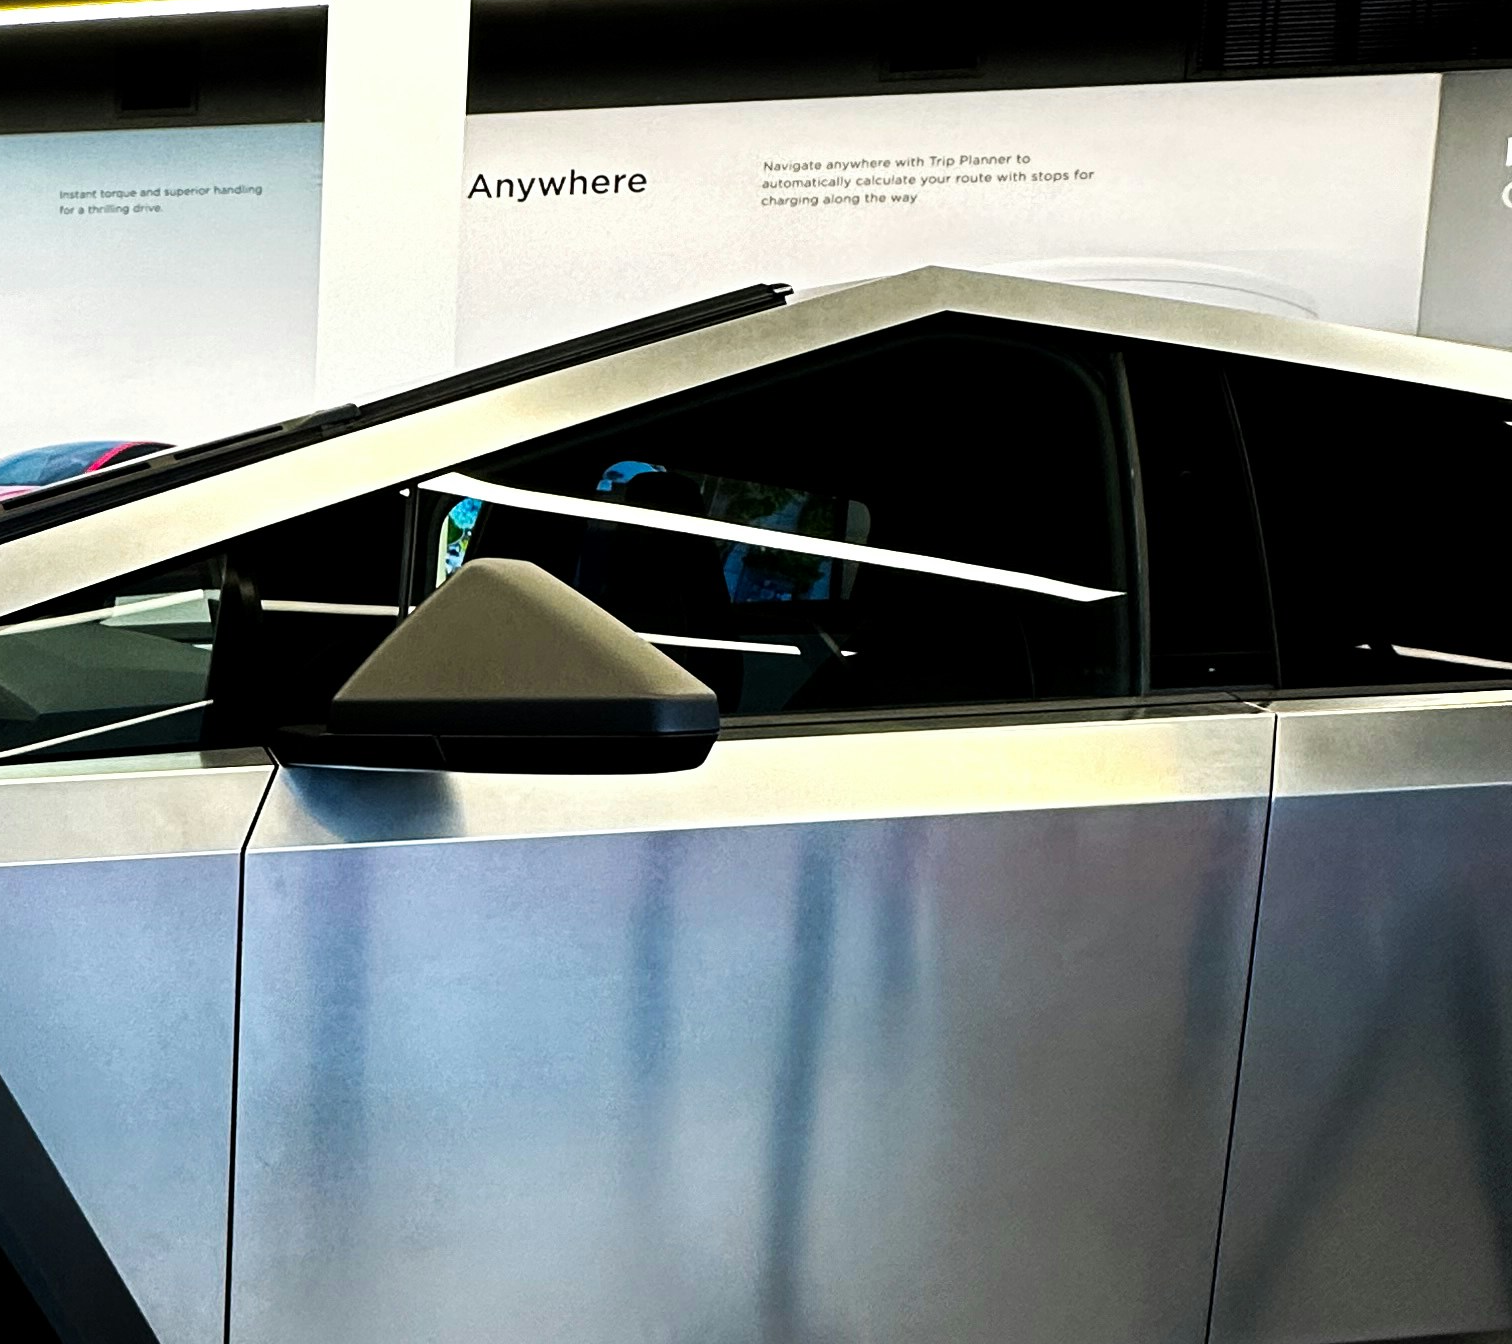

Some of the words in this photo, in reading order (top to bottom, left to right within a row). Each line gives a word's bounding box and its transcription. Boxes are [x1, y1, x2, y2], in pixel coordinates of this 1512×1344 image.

[763, 160, 822, 175] Navigate
[826, 157, 892, 171] anywhere
[895, 155, 925, 168] with
[929, 154, 956, 169] Trip
[959, 154, 1013, 167] Planner
[1016, 153, 1032, 165] to
[467, 168, 648, 203] Anywhere
[761, 175, 852, 190] automatically
[855, 173, 917, 187] calculate
[920, 173, 951, 187] your
[955, 172, 993, 184] route
[996, 170, 1028, 183] with
[1031, 169, 1070, 184] stops
[1073, 169, 1095, 181] for
[59, 189, 97, 200] Instant
[100, 188, 138, 201] torque
[140, 187, 162, 197] and
[164, 185, 211, 199] superior
[213, 184, 264, 197] handling
[760, 194, 819, 208] charging
[823, 192, 861, 206] along
[864, 191, 887, 204] the
[890, 192, 918, 206] way
[59, 205, 75, 216] for
[78, 207, 86, 215] a
[88, 203, 130, 216] thrilling
